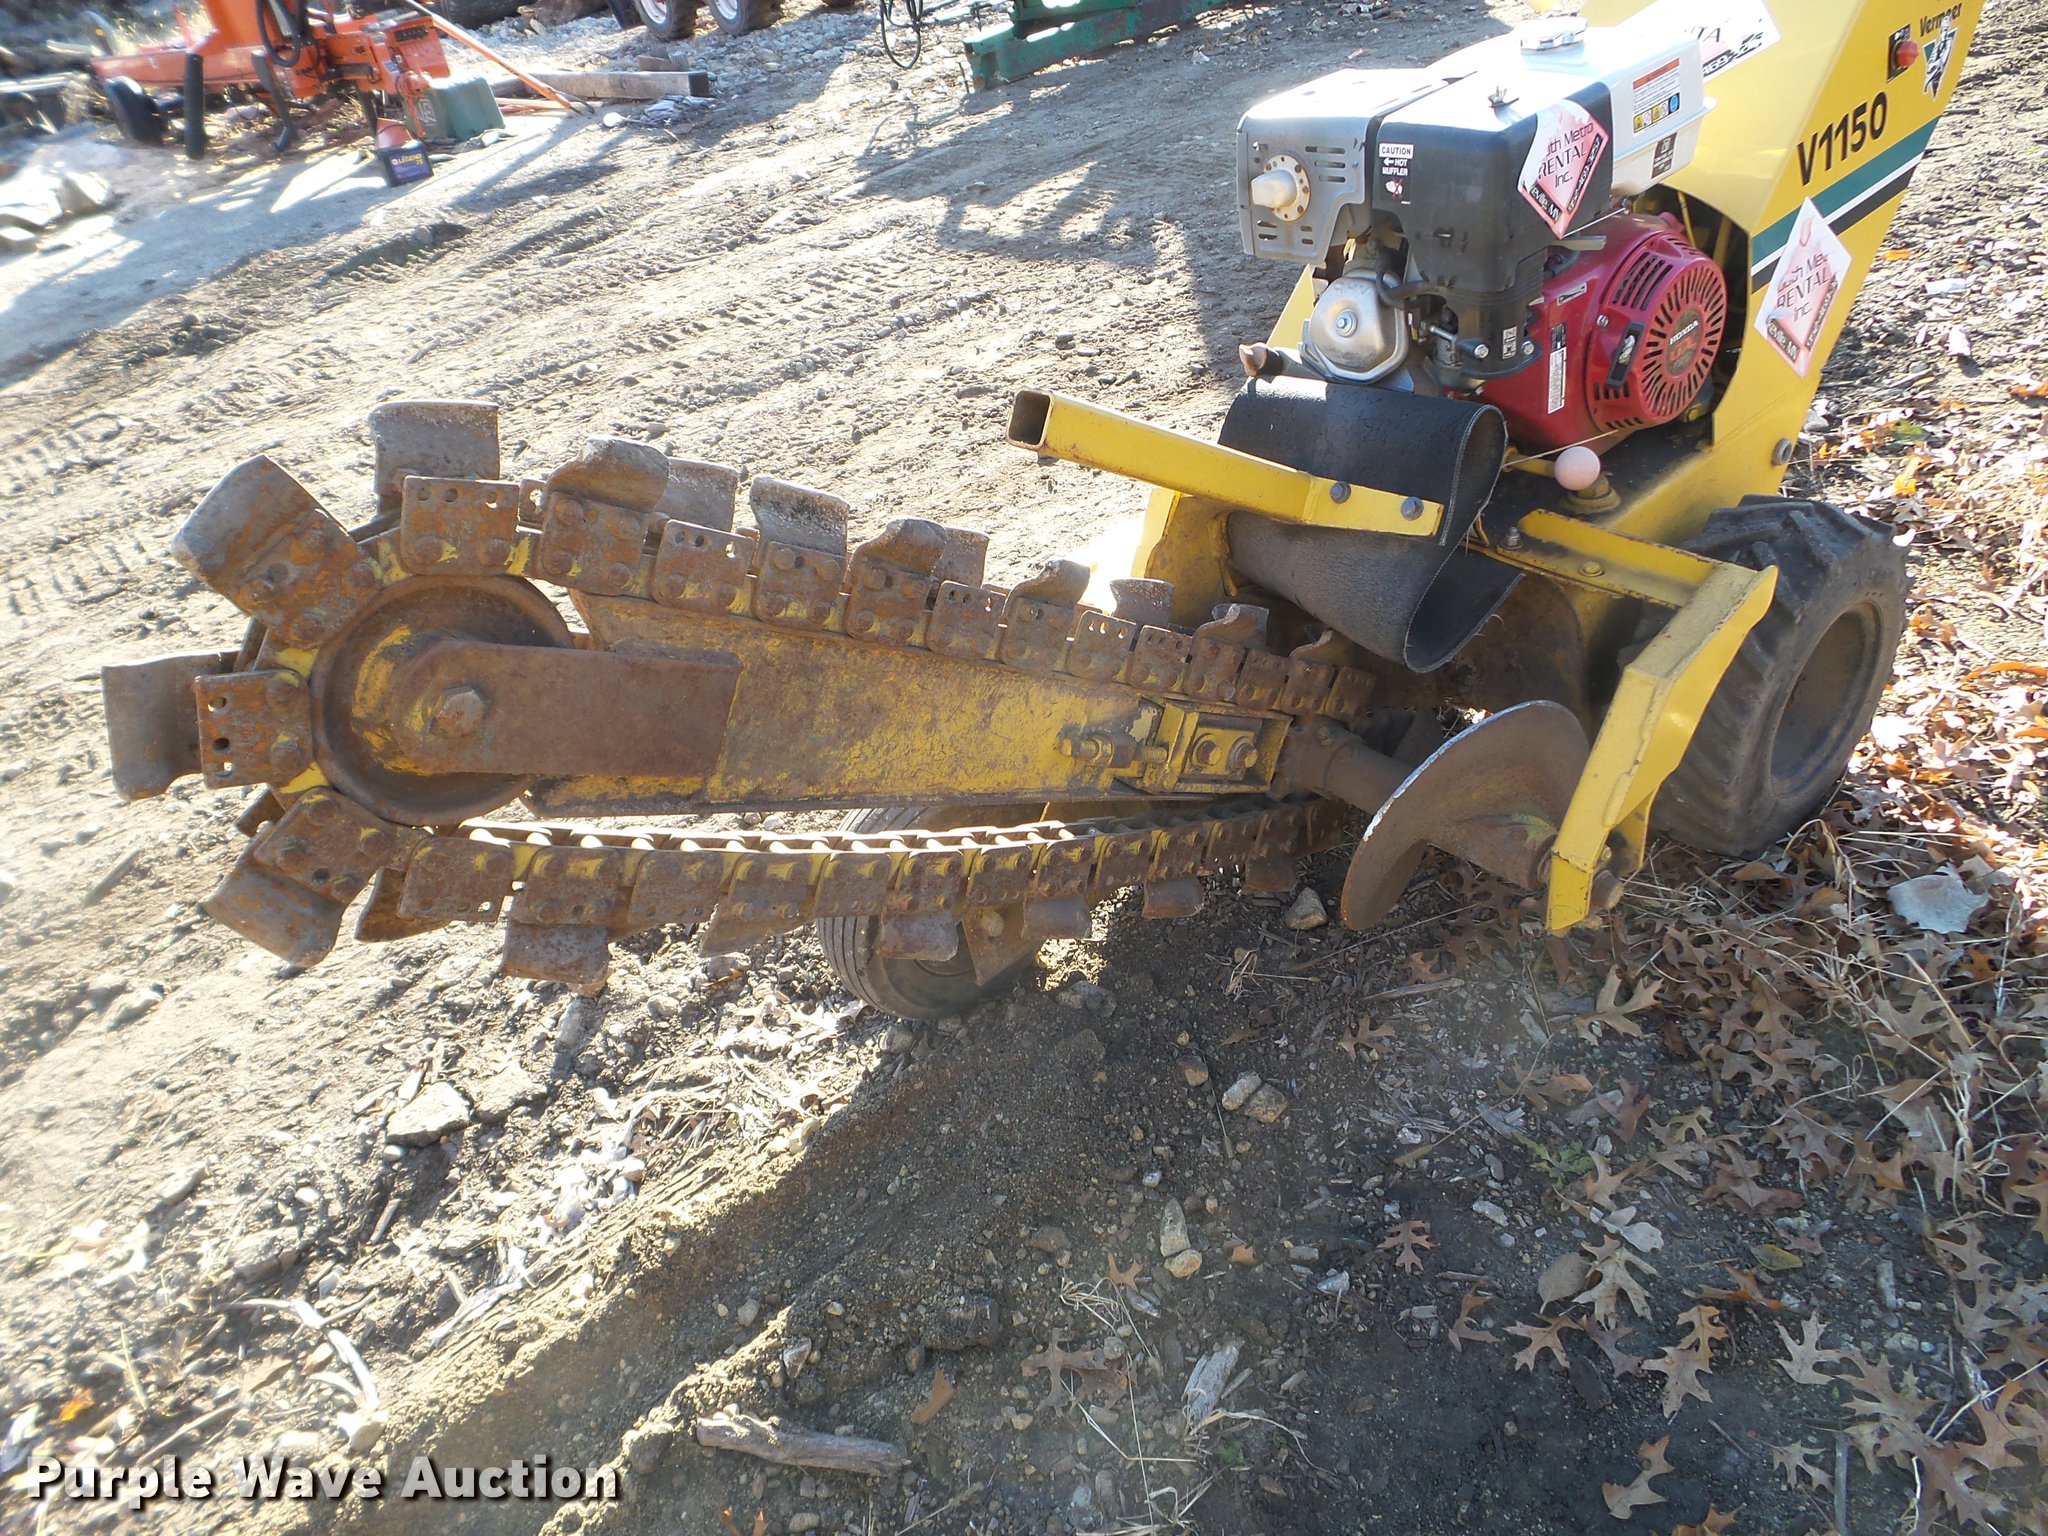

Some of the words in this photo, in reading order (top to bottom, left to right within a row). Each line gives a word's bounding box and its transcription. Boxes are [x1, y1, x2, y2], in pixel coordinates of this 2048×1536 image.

[1920, 3, 1962, 37] Vermeer
[1564, 122, 1594, 147] Metro
[1797, 91, 1888, 187] V1150
[399, 153, 422, 164] LEGEND
[1381, 146, 1412, 156] CAUTION
[1394, 158, 1408, 167] HOT
[1538, 141, 1588, 180] RENTAL
[1382, 166, 1409, 176] MUFFLER
[1555, 171, 1574, 188] Inc.
[1777, 267, 1829, 308] RENTAL
[1670, 320, 1699, 345] HONDA
